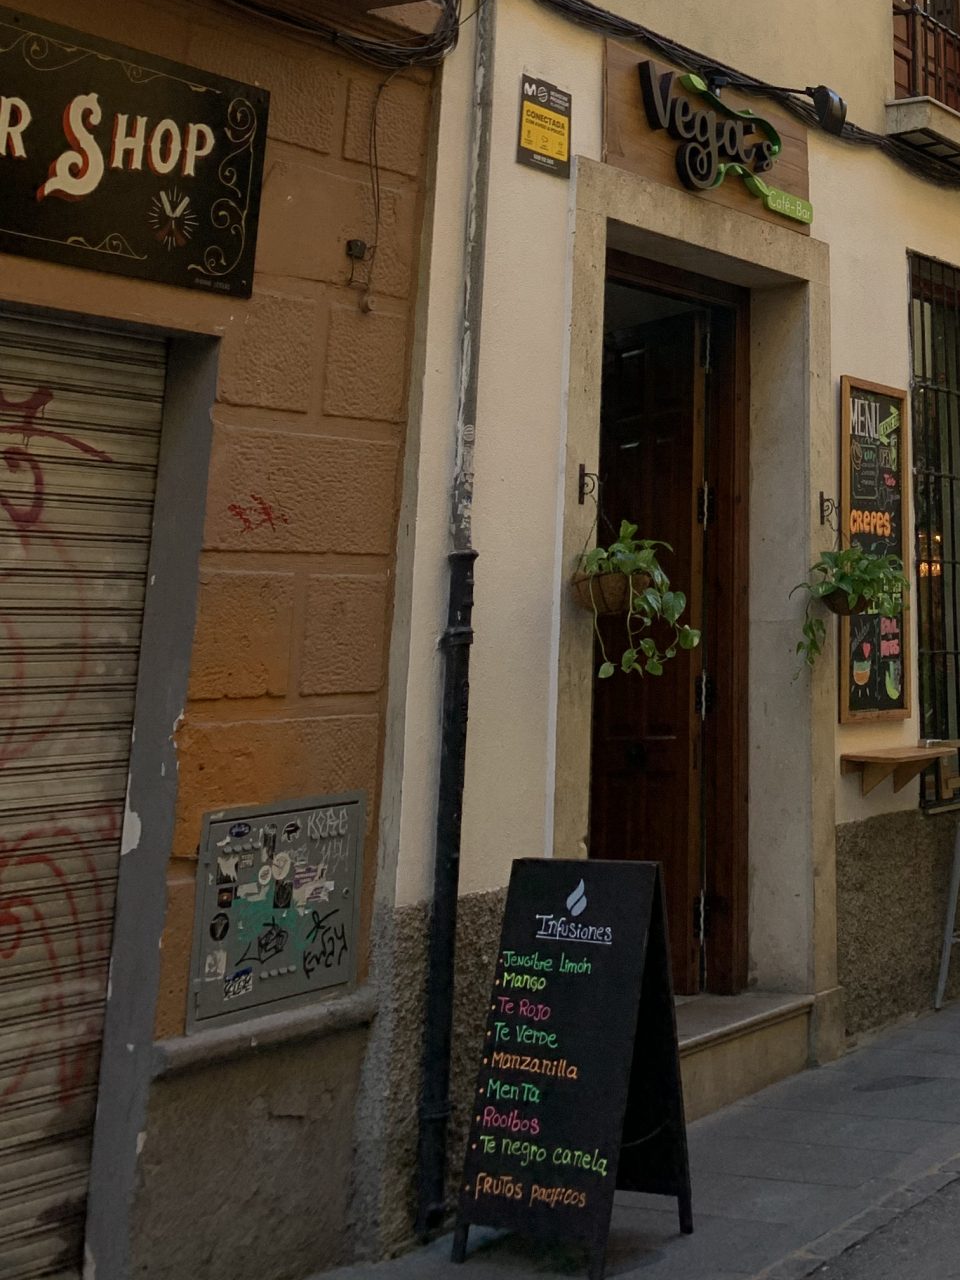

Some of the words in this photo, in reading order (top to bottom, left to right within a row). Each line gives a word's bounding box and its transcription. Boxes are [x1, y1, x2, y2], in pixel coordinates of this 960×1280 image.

[525, 109, 566, 131] CONECTADA
[35, 92, 216, 202] SHOP
[768, 191, 811, 219] Café-Bar
[535, 914, 613, 942] Infusiones
[497, 996, 514, 1013] Te
[494, 1022, 511, 1042] Te
[491, 1051, 579, 1079] Manzanilla
[482, 1106, 541, 1135] Rooibos
[479, 1135, 496, 1154] Te
[502, 1138, 547, 1167] negro
[552, 1148, 608, 1177] canela
